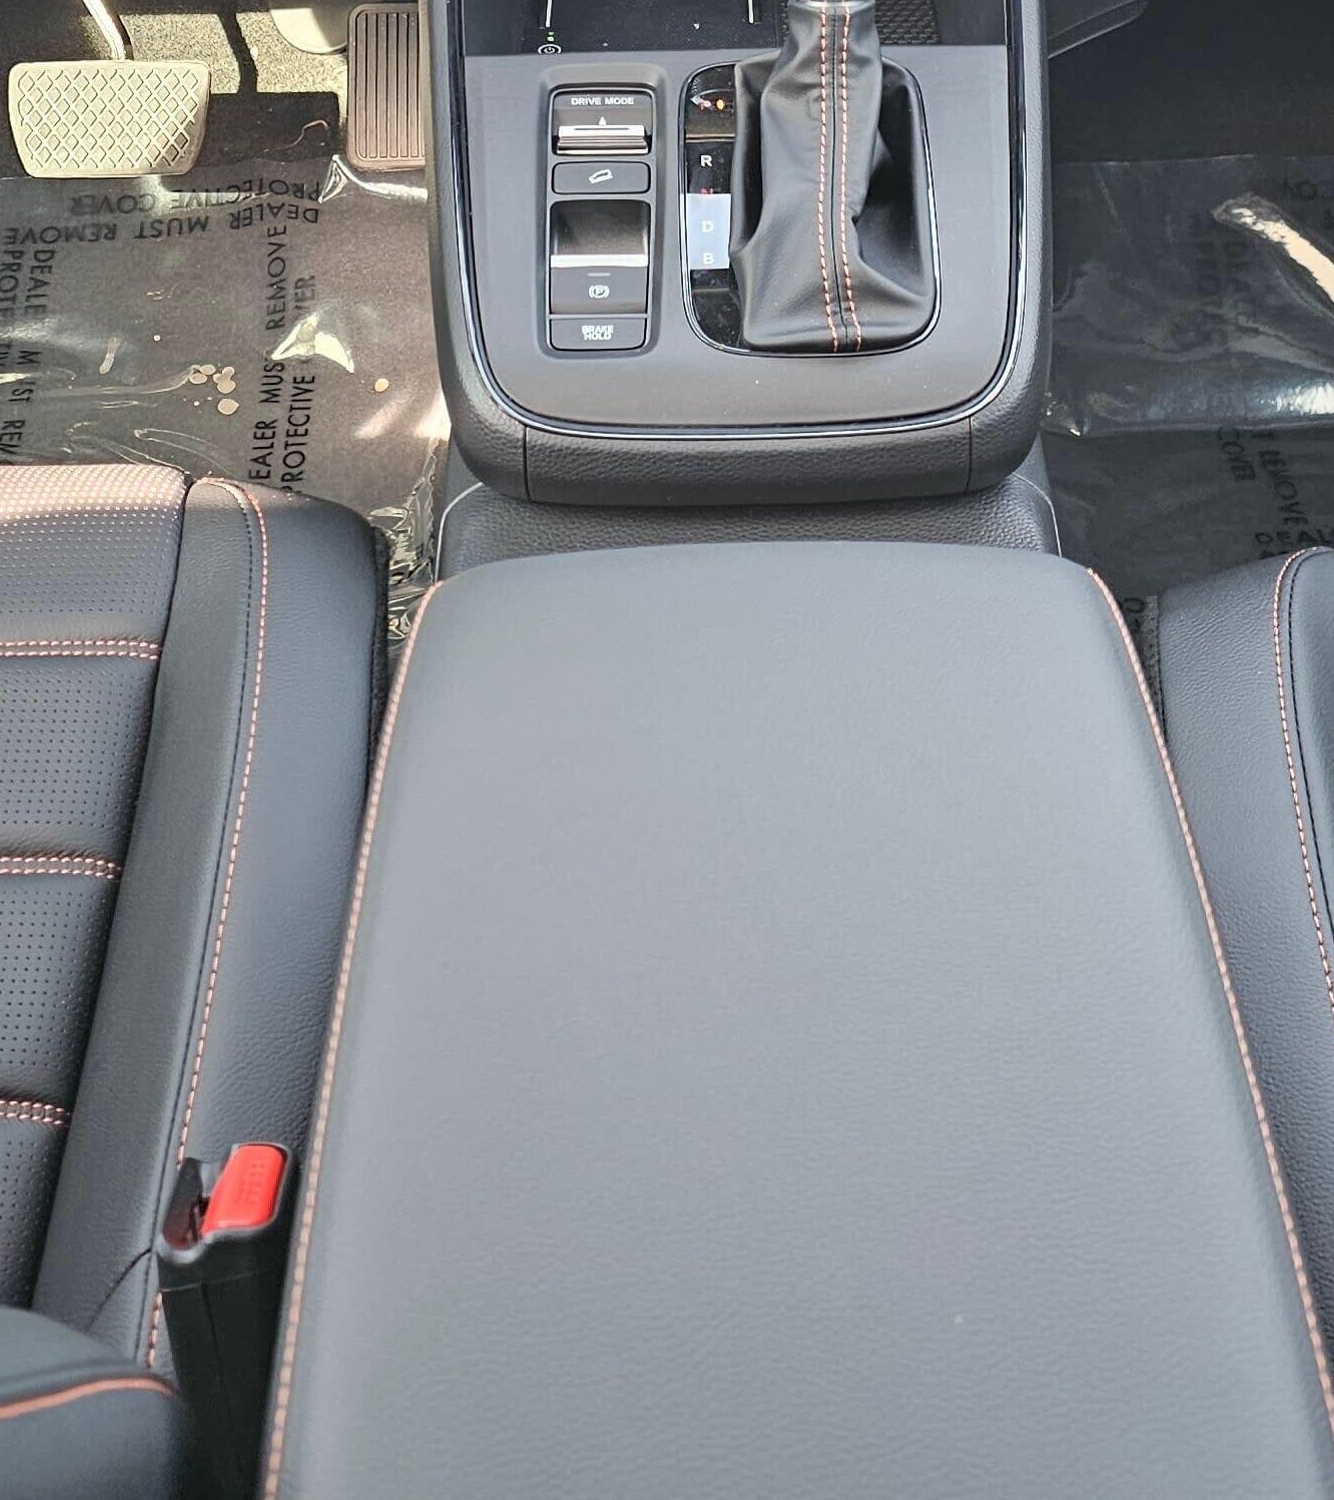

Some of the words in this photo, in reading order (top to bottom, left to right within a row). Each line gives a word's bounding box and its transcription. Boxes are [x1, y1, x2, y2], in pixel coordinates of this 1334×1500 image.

[571, 97, 601, 106] DRIVE
[604, 96, 634, 105] MODE
[701, 155, 713, 167] R
[228, 202, 320, 231] DEALER
[133, 216, 209, 240] MUST
[702, 221, 714, 232] D
[3, 223, 117, 246] REMOVE
[703, 253, 714, 264] B
[266, 224, 288, 330] REMOVE
[582, 325, 613, 334] BRAKE
[583, 332, 612, 341] HOLD
[1259, 449, 1309, 526] REMOVE
